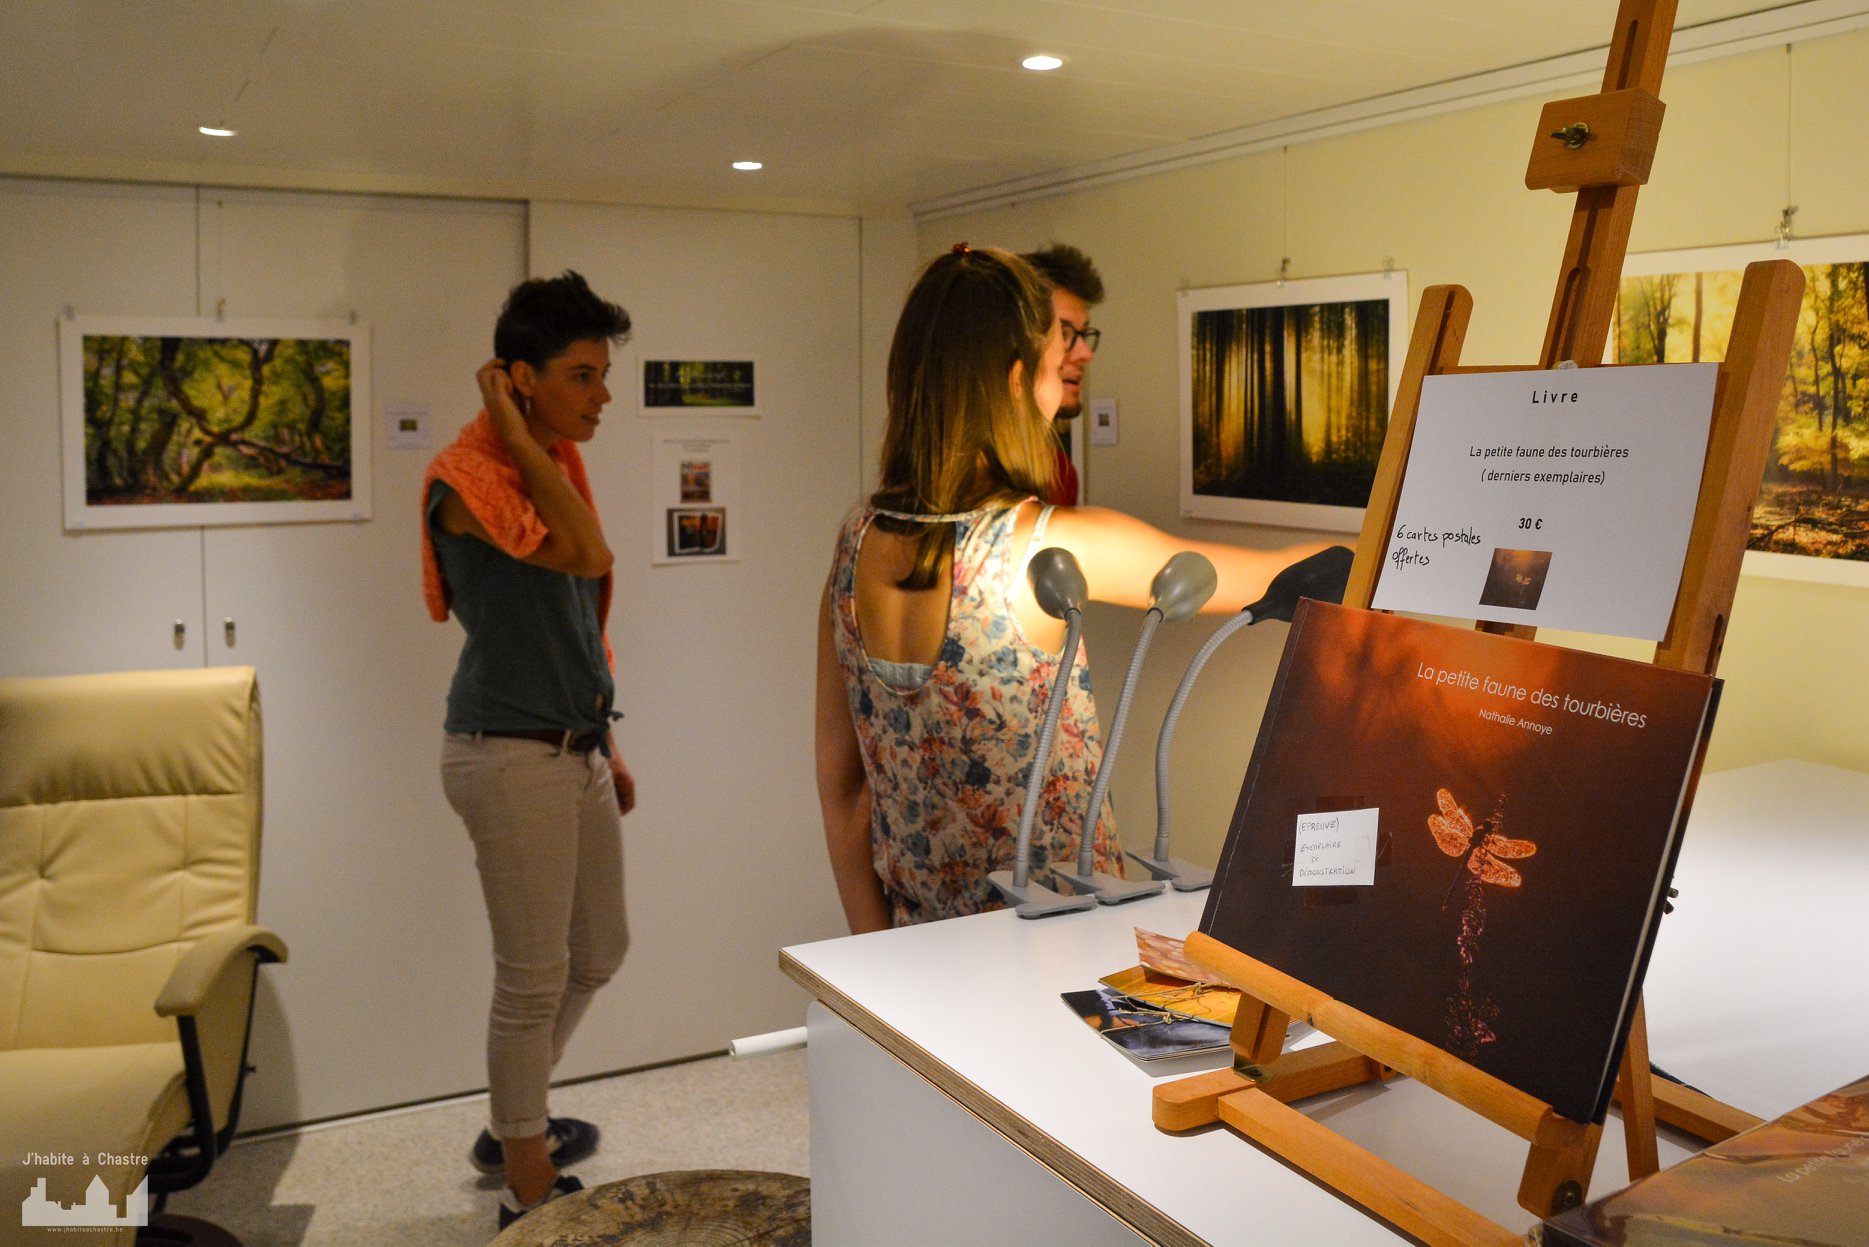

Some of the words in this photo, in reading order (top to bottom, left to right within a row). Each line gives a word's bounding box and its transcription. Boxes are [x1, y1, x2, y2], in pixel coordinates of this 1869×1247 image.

[1532, 390, 1578, 404] Livre
[1469, 446, 1482, 457] La
[1484, 446, 1513, 460] petite
[1515, 446, 1545, 458] faune
[1548, 446, 1567, 458] des
[1570, 445, 1629, 458] tourbières
[1533, 471, 1606, 485] exemplaires)
[1518, 517, 1532, 530] 30
[1396, 524, 1406, 539] 6
[1406, 526, 1438, 542] cartes
[1442, 526, 1481, 548] postales
[1392, 546, 1430, 571] offertes
[1417, 662, 1435, 680] La
[1436, 669, 1479, 690] petite
[1482, 676, 1527, 701] faune
[1530, 688, 1560, 709] des
[1563, 693, 1648, 729] tourbières
[1478, 708, 1516, 726] Nathalie
[1516, 717, 1553, 736] Annoye
